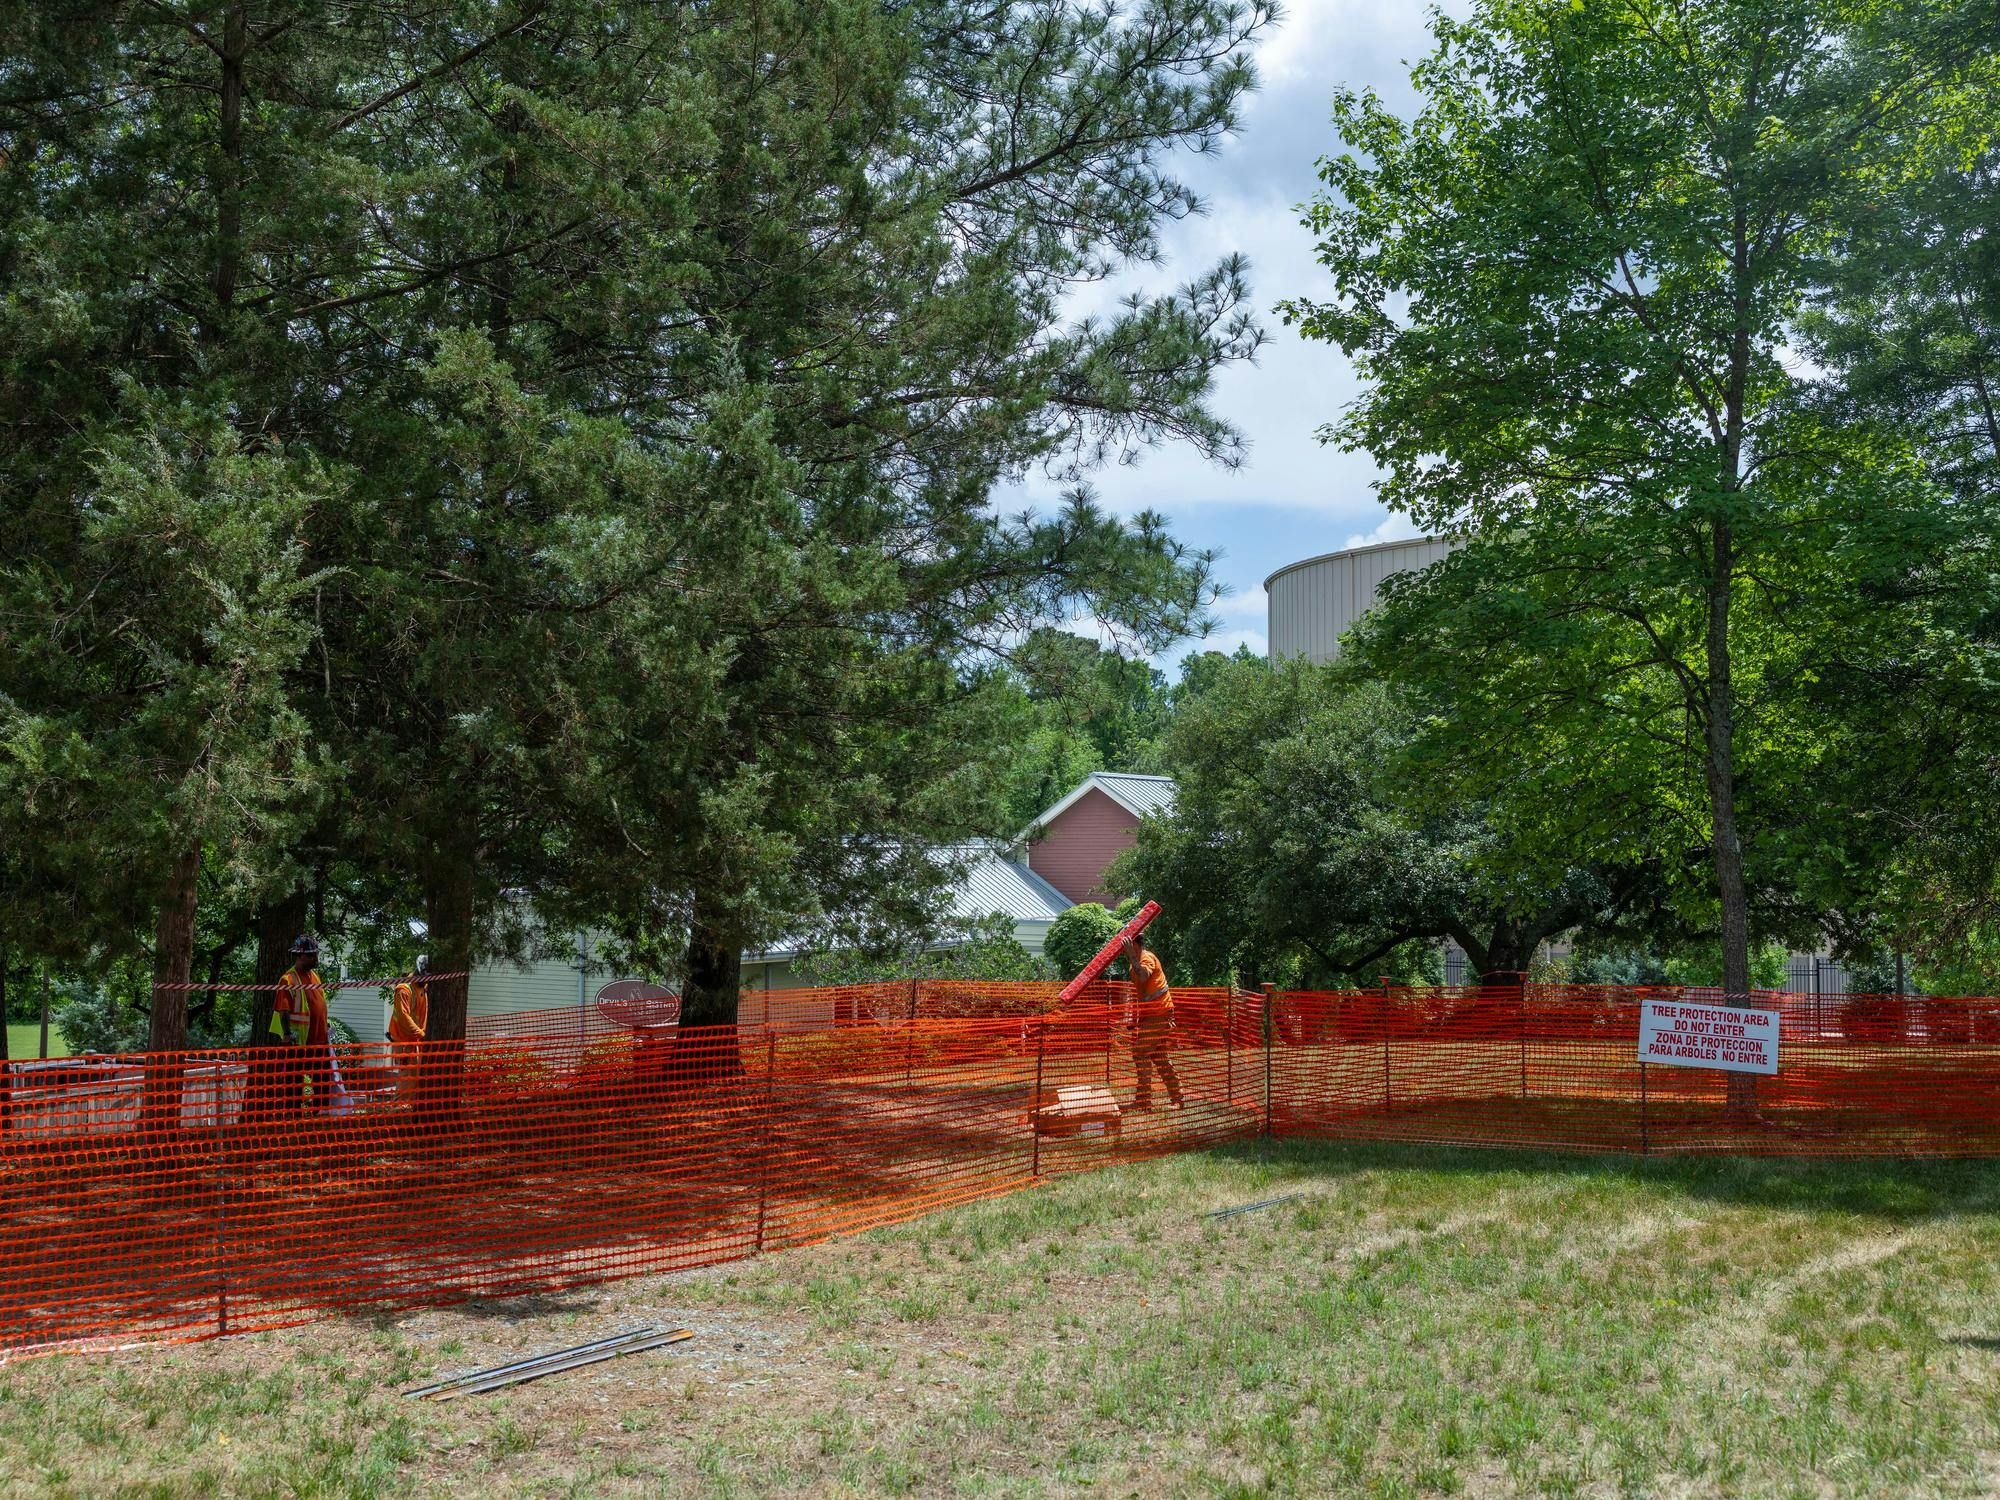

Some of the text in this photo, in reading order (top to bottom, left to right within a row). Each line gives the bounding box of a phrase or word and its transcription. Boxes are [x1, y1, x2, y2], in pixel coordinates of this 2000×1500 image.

[1652, 1005, 1769, 1026] TREE PROTECTION AREA
[1675, 1020, 1745, 1036] DO NOT ENTER
[1656, 1032, 1762, 1053] ZONA DE PROTECCION
[1649, 1044, 1768, 1065] PARA ARBOLES NO ENTRE
